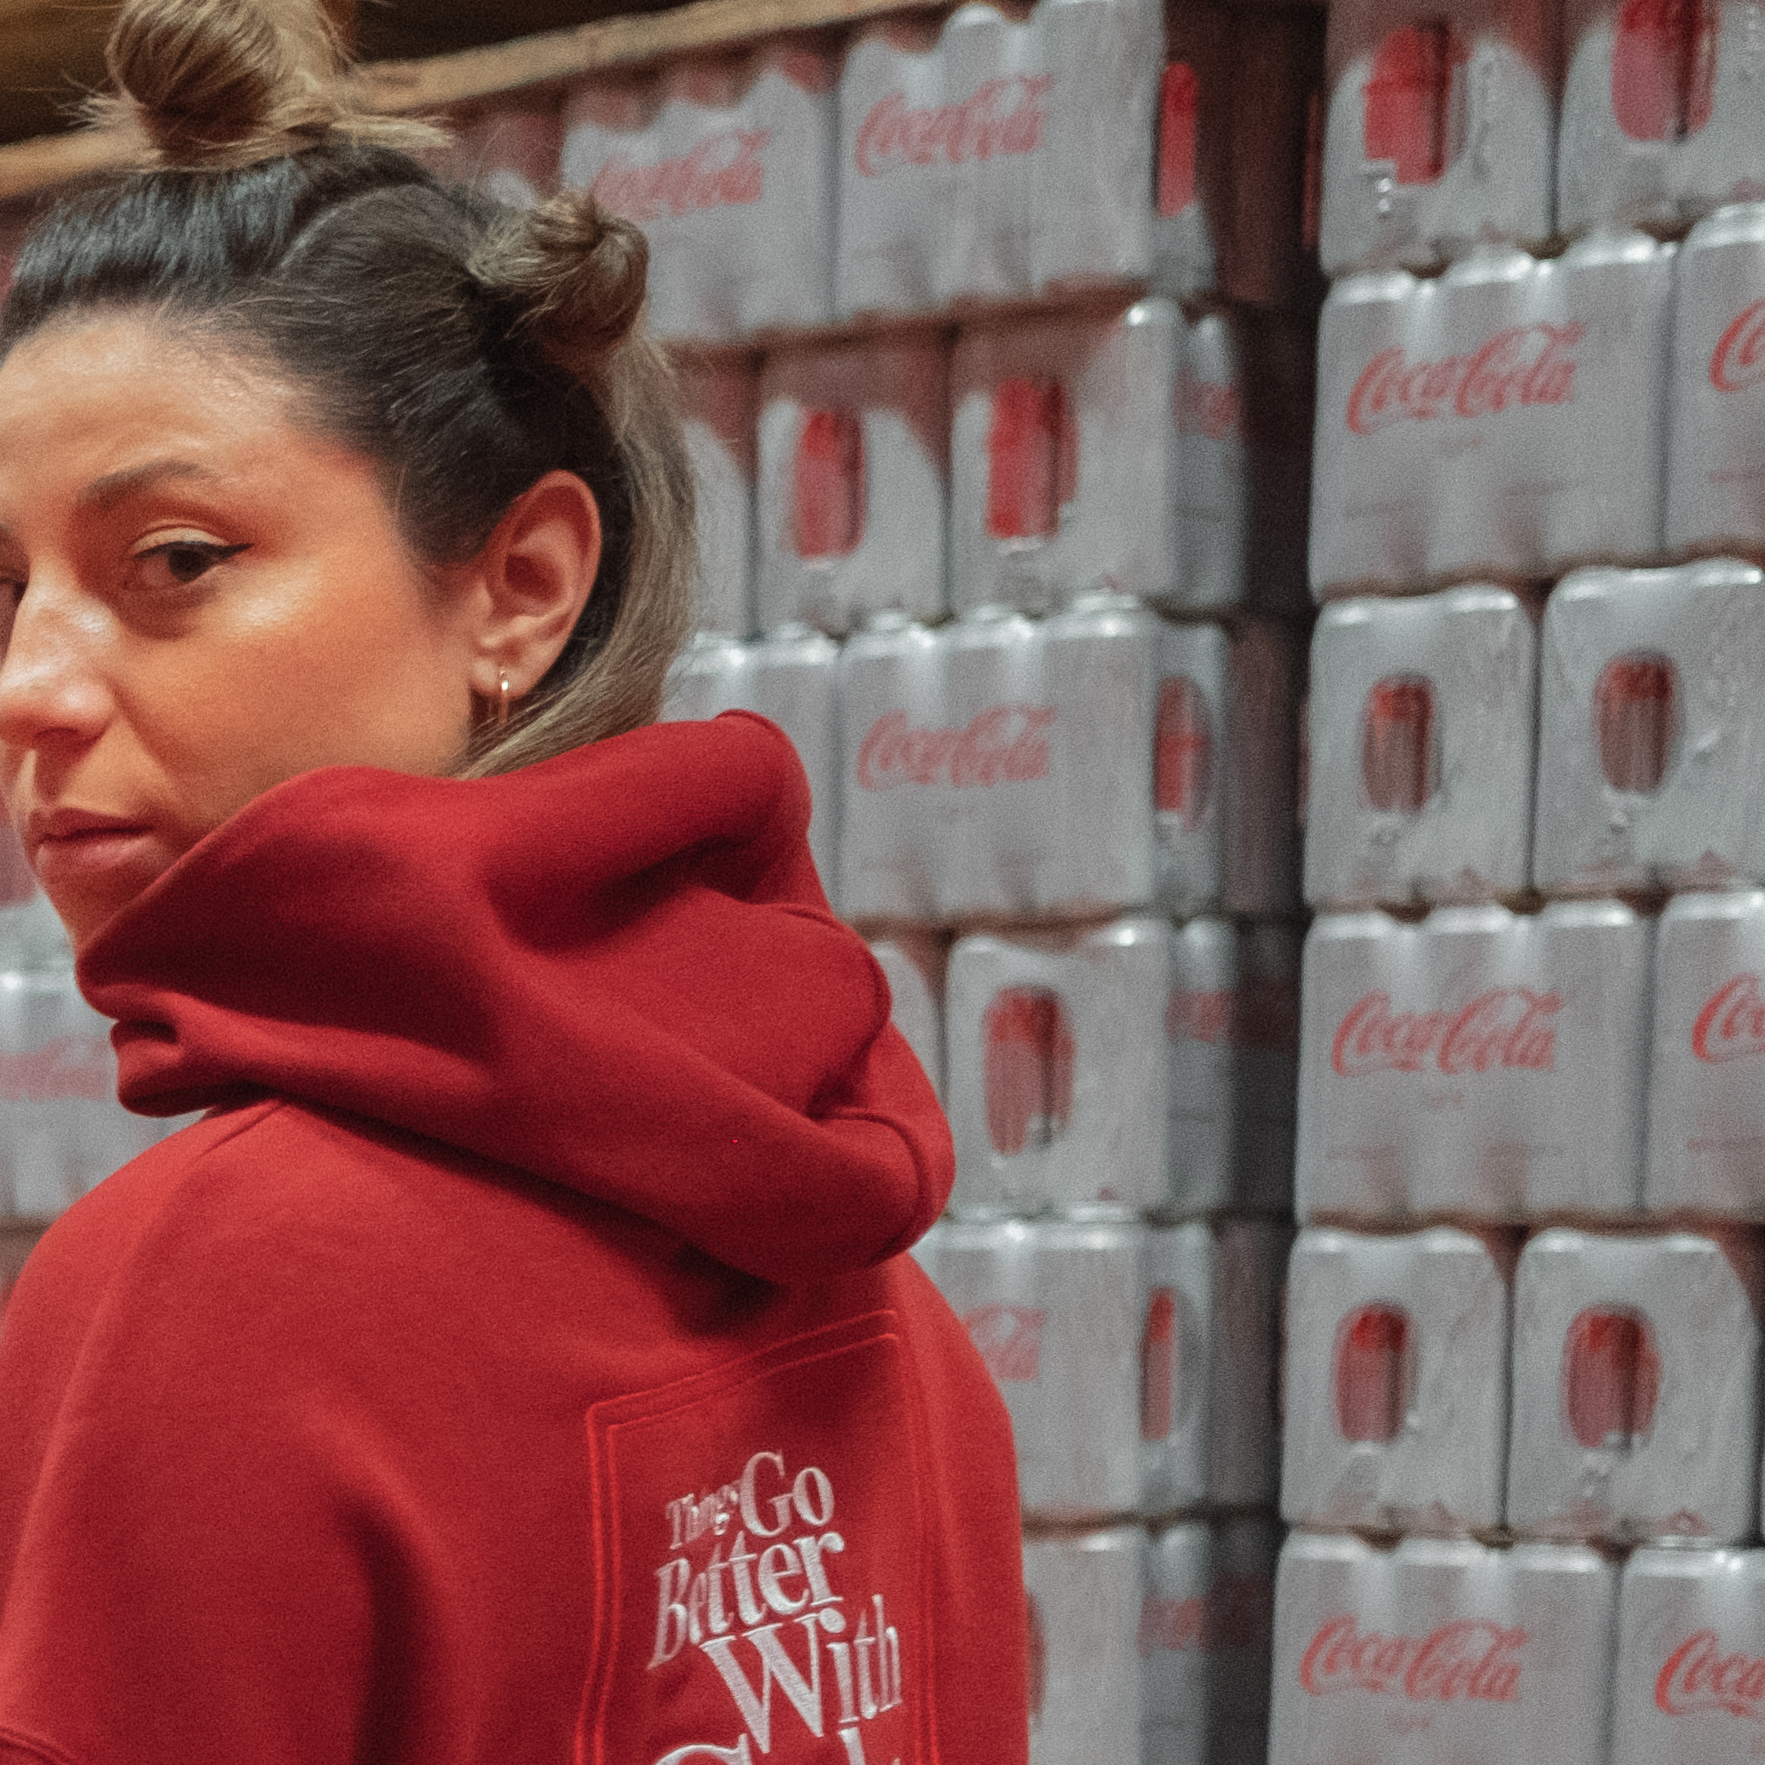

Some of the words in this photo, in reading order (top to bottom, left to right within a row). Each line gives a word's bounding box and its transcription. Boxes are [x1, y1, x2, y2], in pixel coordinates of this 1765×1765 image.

[1345, 320, 1585, 437] Coca-Cola
[740, 1452, 835, 1537] Go
[647, 1530, 845, 1671] Better
[1298, 1612, 1529, 1704] Coca-Cola
[699, 1593, 903, 1754] With
